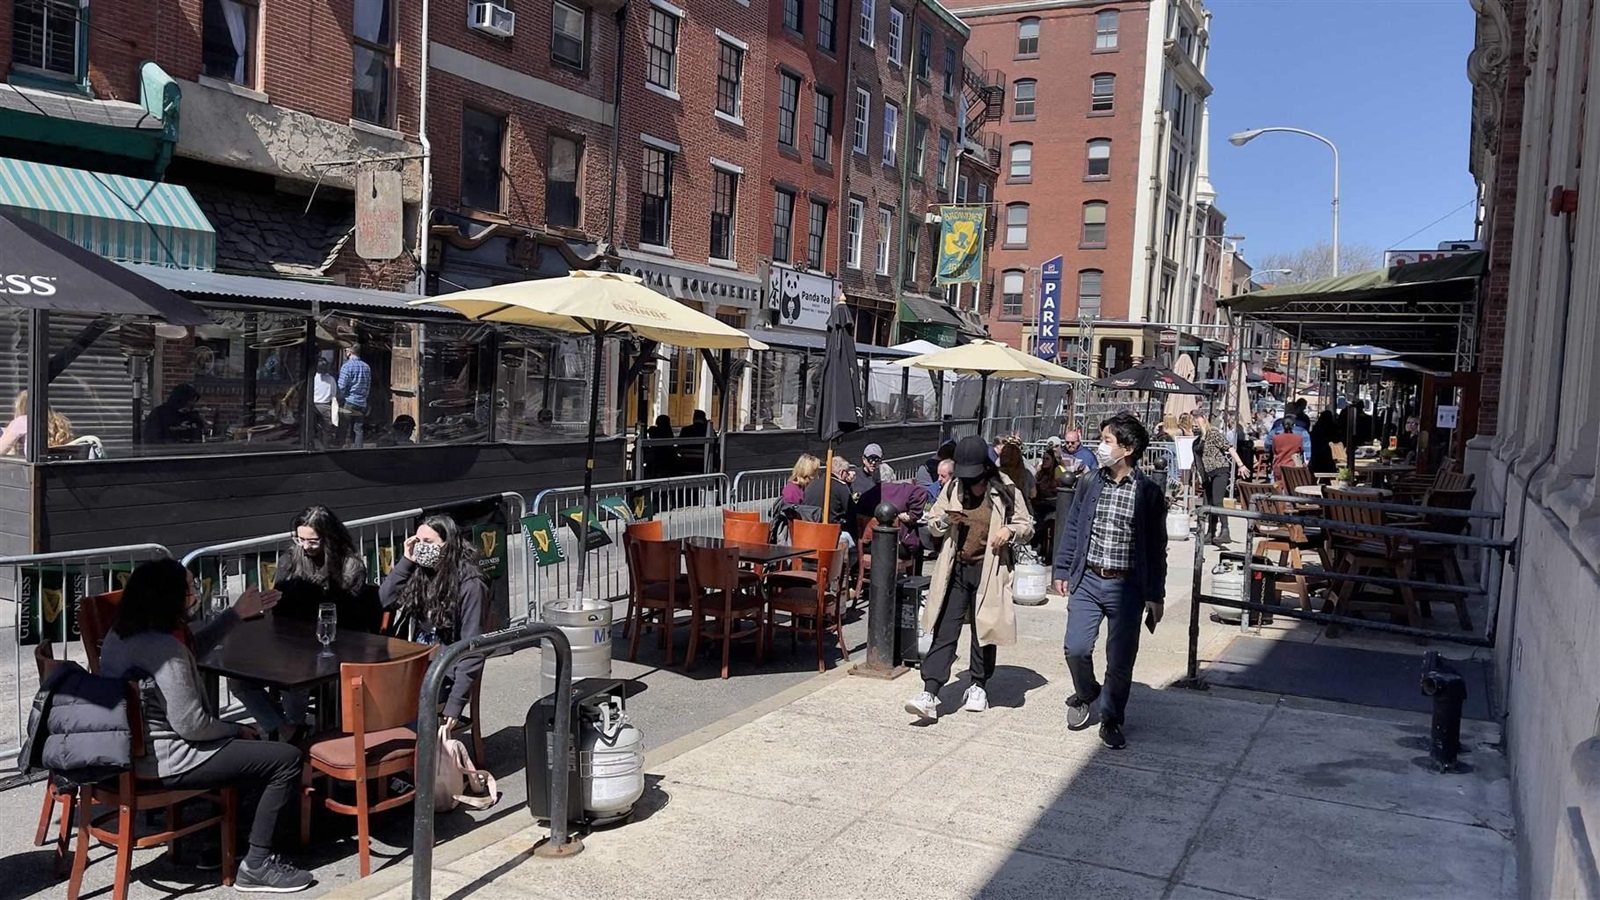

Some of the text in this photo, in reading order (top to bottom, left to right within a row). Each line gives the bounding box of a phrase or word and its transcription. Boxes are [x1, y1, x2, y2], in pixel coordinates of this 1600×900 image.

[682, 276, 758, 301] BOUCHERIE
[801, 290, 831, 305] Panda Tea
[1043, 282, 1056, 337] PARK
[20, 575, 32, 639] GUINNESS
[71, 574, 82, 636] GNNESS
